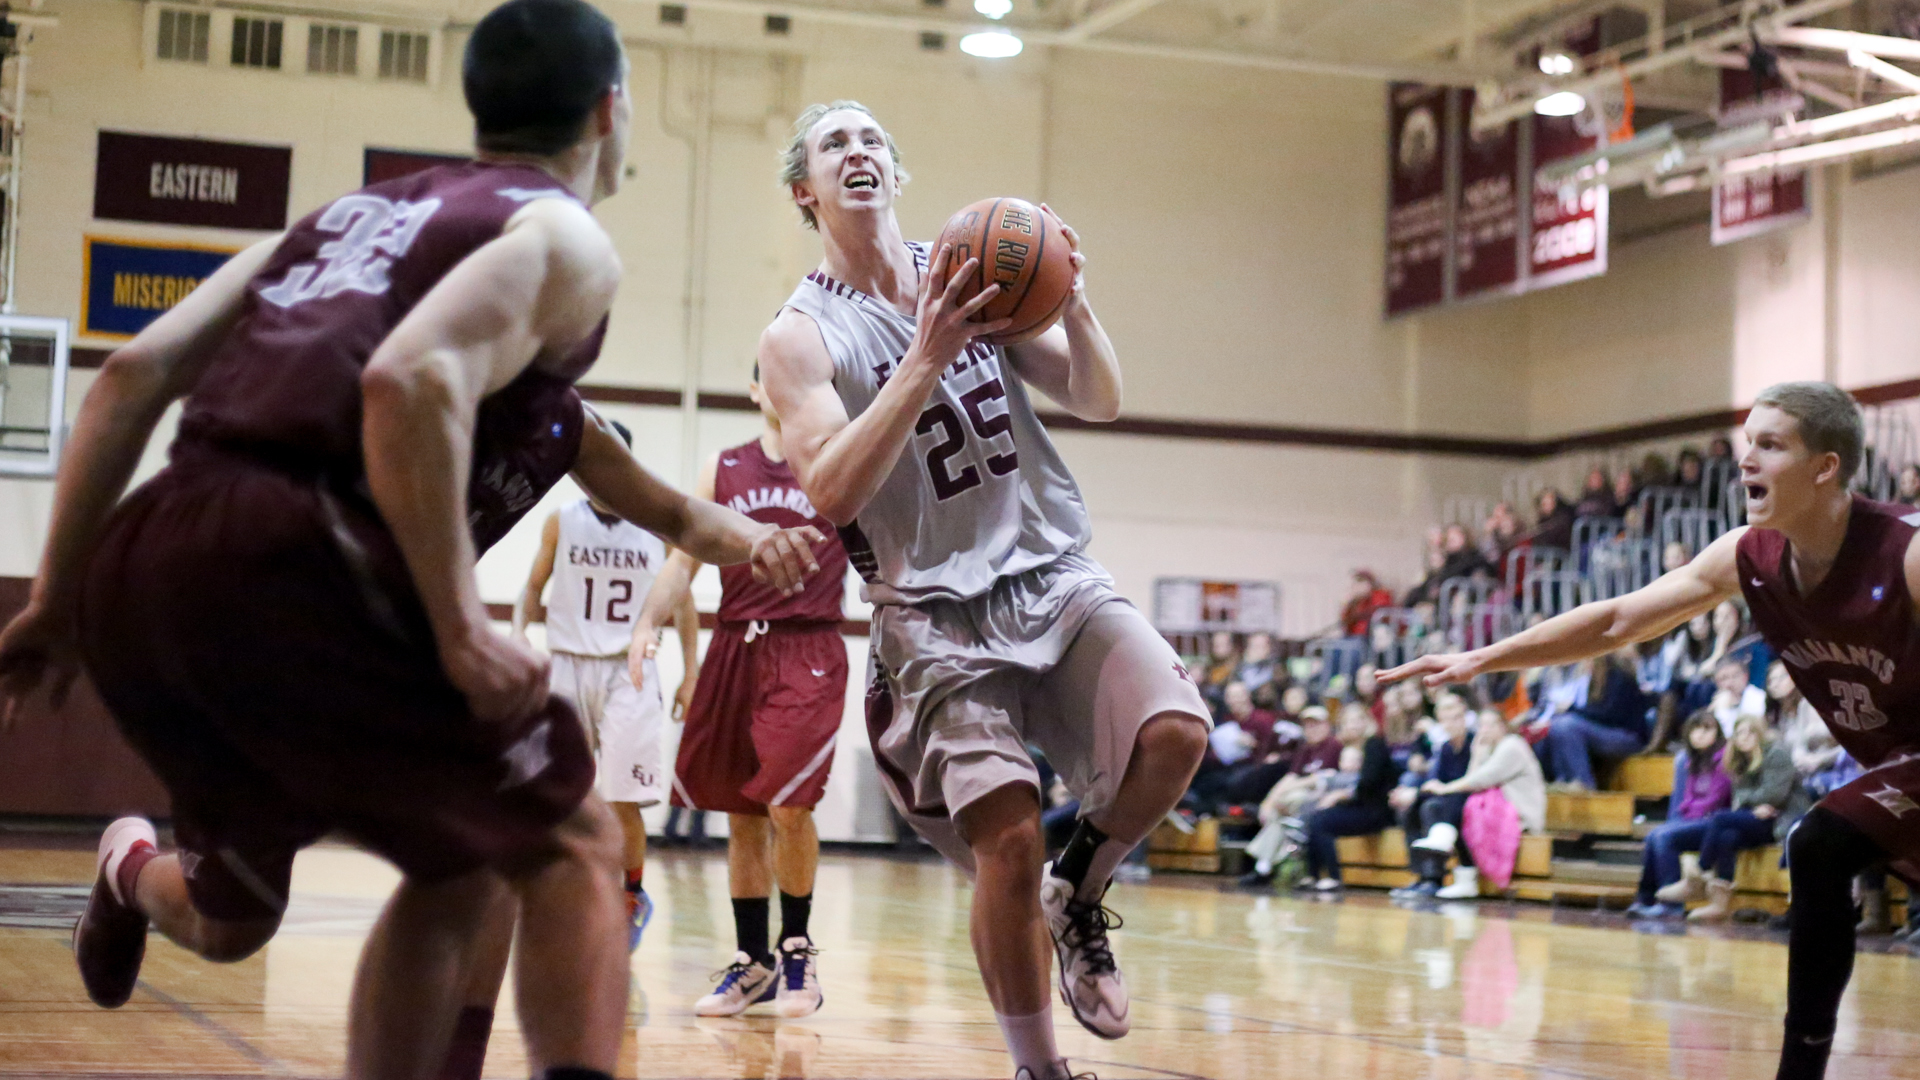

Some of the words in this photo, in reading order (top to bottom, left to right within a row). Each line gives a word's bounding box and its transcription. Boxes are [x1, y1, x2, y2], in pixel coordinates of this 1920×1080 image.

[150, 161, 238, 205] EASTERN
[994, 237, 1030, 292] ROCK
[915, 378, 1019, 502] 25
[569, 544, 649, 569] EASTERN
[584, 577, 633, 623] 12
[1828, 678, 1889, 731] 33
